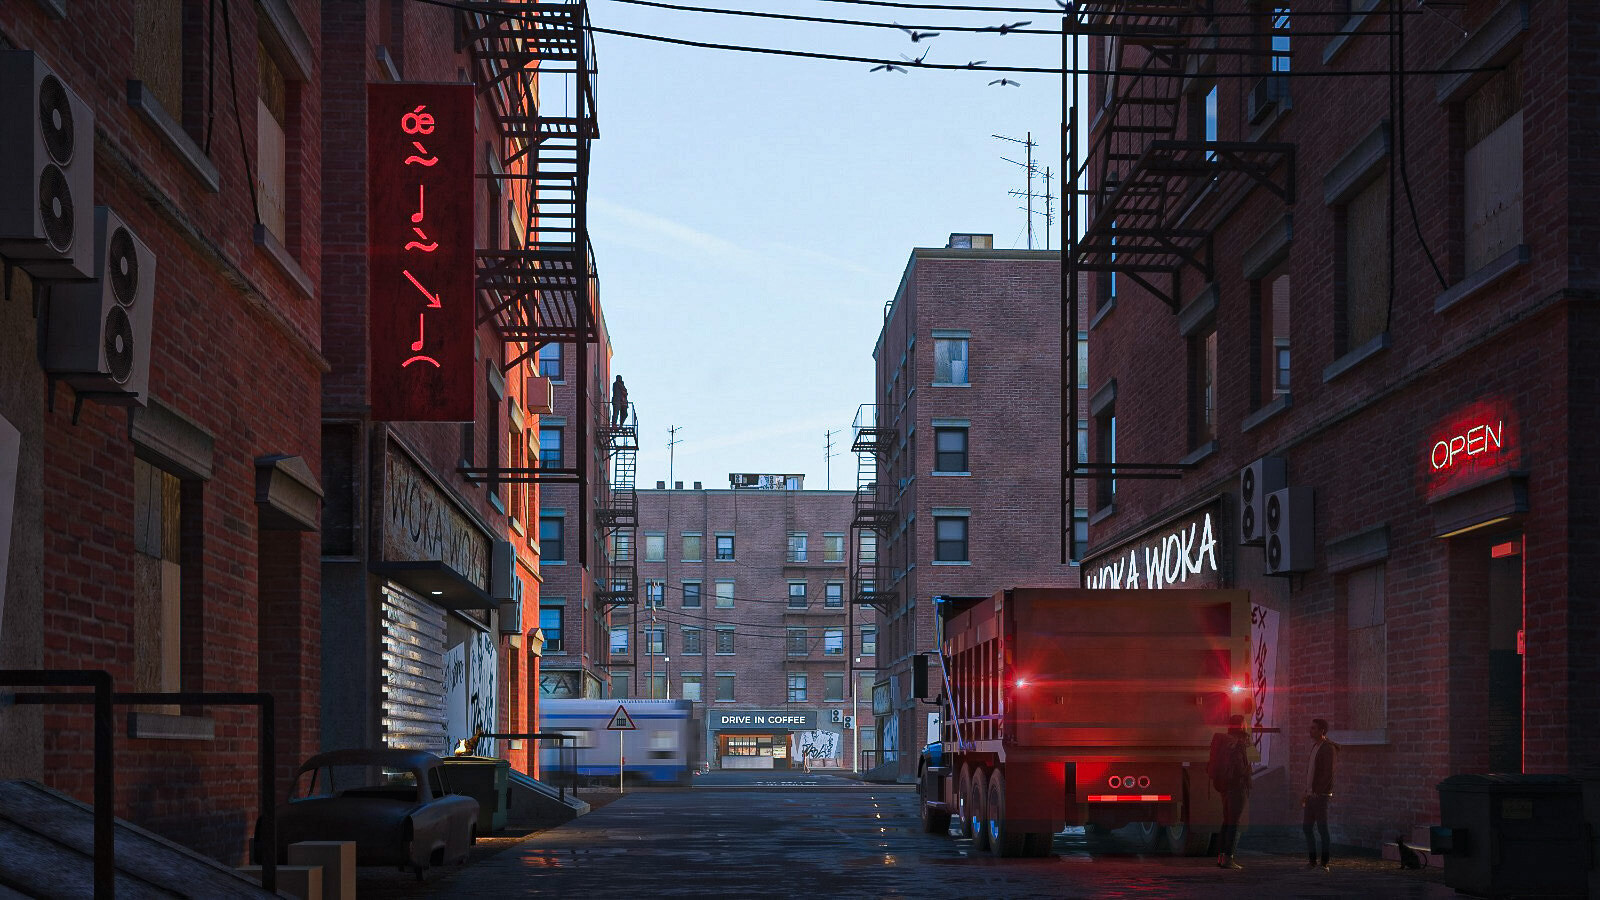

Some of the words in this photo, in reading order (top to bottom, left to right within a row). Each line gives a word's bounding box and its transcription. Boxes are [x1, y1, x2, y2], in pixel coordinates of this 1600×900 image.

[1431, 420, 1502, 470] OPEN
[390, 458, 444, 562] WOKA
[1145, 512, 1217, 590] WOKA
[721, 715, 751, 725] DRIVE
[754, 715, 765, 725] IN
[768, 715, 806, 725] COFFEE
